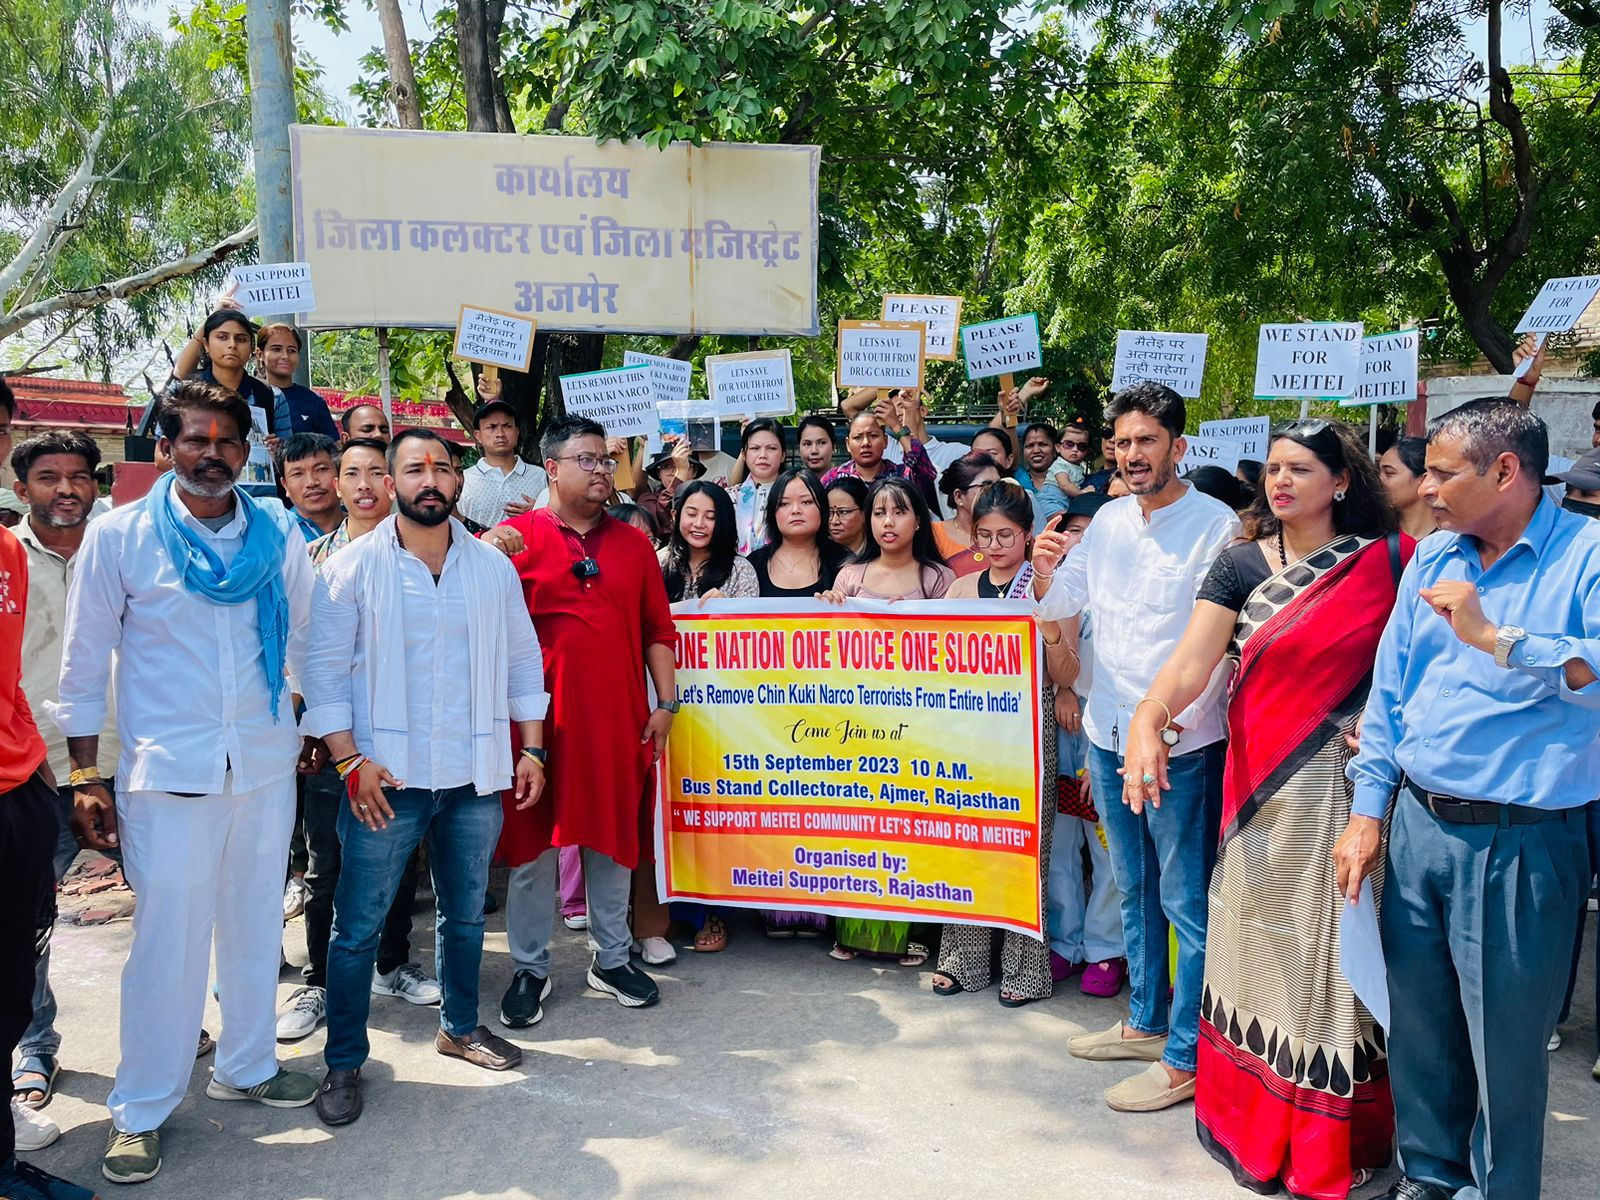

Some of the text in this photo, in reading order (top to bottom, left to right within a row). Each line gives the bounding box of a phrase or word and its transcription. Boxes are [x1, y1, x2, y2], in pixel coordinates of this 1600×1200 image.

[494, 155, 630, 200] कार्यालय
[314, 208, 402, 250] जिला
[408, 220, 530, 254] कलक्टर
[539, 212, 589, 256] एवं
[590, 216, 674, 258] जिला
[255, 267, 306, 282] SUPPORT
[1544, 278, 1599, 292] WE STAND
[248, 286, 301, 303] MEITEI
[514, 272, 619, 314] अजमेर
[891, 303, 949, 315] PLEASE
[1549, 297, 1572, 308] FOR
[1526, 315, 1571, 328] MEITEI
[970, 323, 1024, 341] PLEASE
[1265, 327, 1356, 342] WE STAND
[859, 337, 901, 348] LETS SAVE
[981, 339, 1018, 354] SAVE
[1367, 336, 1413, 354] STAND
[843, 352, 916, 363] OUR YOUTH FROM
[970, 351, 1036, 371] MANIPUR
[1292, 350, 1327, 365] FOR
[730, 366, 768, 378] LETS SAVE
[850, 367, 911, 378] DRUG CARTELS
[1365, 360, 1392, 375] FOR
[566, 372, 645, 391] LETS REMOVE THIS
[718, 378, 783, 392] OUR YOUTH FROM
[1270, 375, 1345, 391] MEITEI
[569, 394, 592, 405] CHIN
[593, 390, 616, 402] KUKI
[617, 386, 650, 398] NARCO
[726, 392, 780, 404] DRUG CARTELS
[627, 401, 651, 413] FROM
[619, 417, 642, 427] INDIA
[1202, 424, 1266, 437] WE SUPPORT
[1187, 445, 1220, 459] ASE
[675, 629, 1022, 676] ONE NATION ONE VOICE ONE SLOGAN
[706, 685, 754, 705] Remove
[757, 684, 786, 704] Chin
[789, 684, 815, 705] Kuki
[819, 685, 854, 706] Narco
[857, 684, 912, 707] Terrorists
[916, 687, 946, 709] From
[949, 689, 983, 711] Entire
[784, 719, 909, 745] Come Join us at
[722, 754, 973, 781] 15th September 2023 10 A.M.
[682, 779, 1020, 811] Bus Stand Collectorate, Ajmer, Rajasthan
[683, 810, 701, 826] WE
[704, 811, 757, 827] SUPPORT
[760, 812, 800, 829] MEITEI
[804, 812, 876, 833] COMMUNITY
[914, 819, 951, 839] STAND
[955, 824, 979, 842] FOR
[794, 846, 907, 873] Organised by:
[732, 869, 973, 903] Meitei Supporters, Rajasthan
